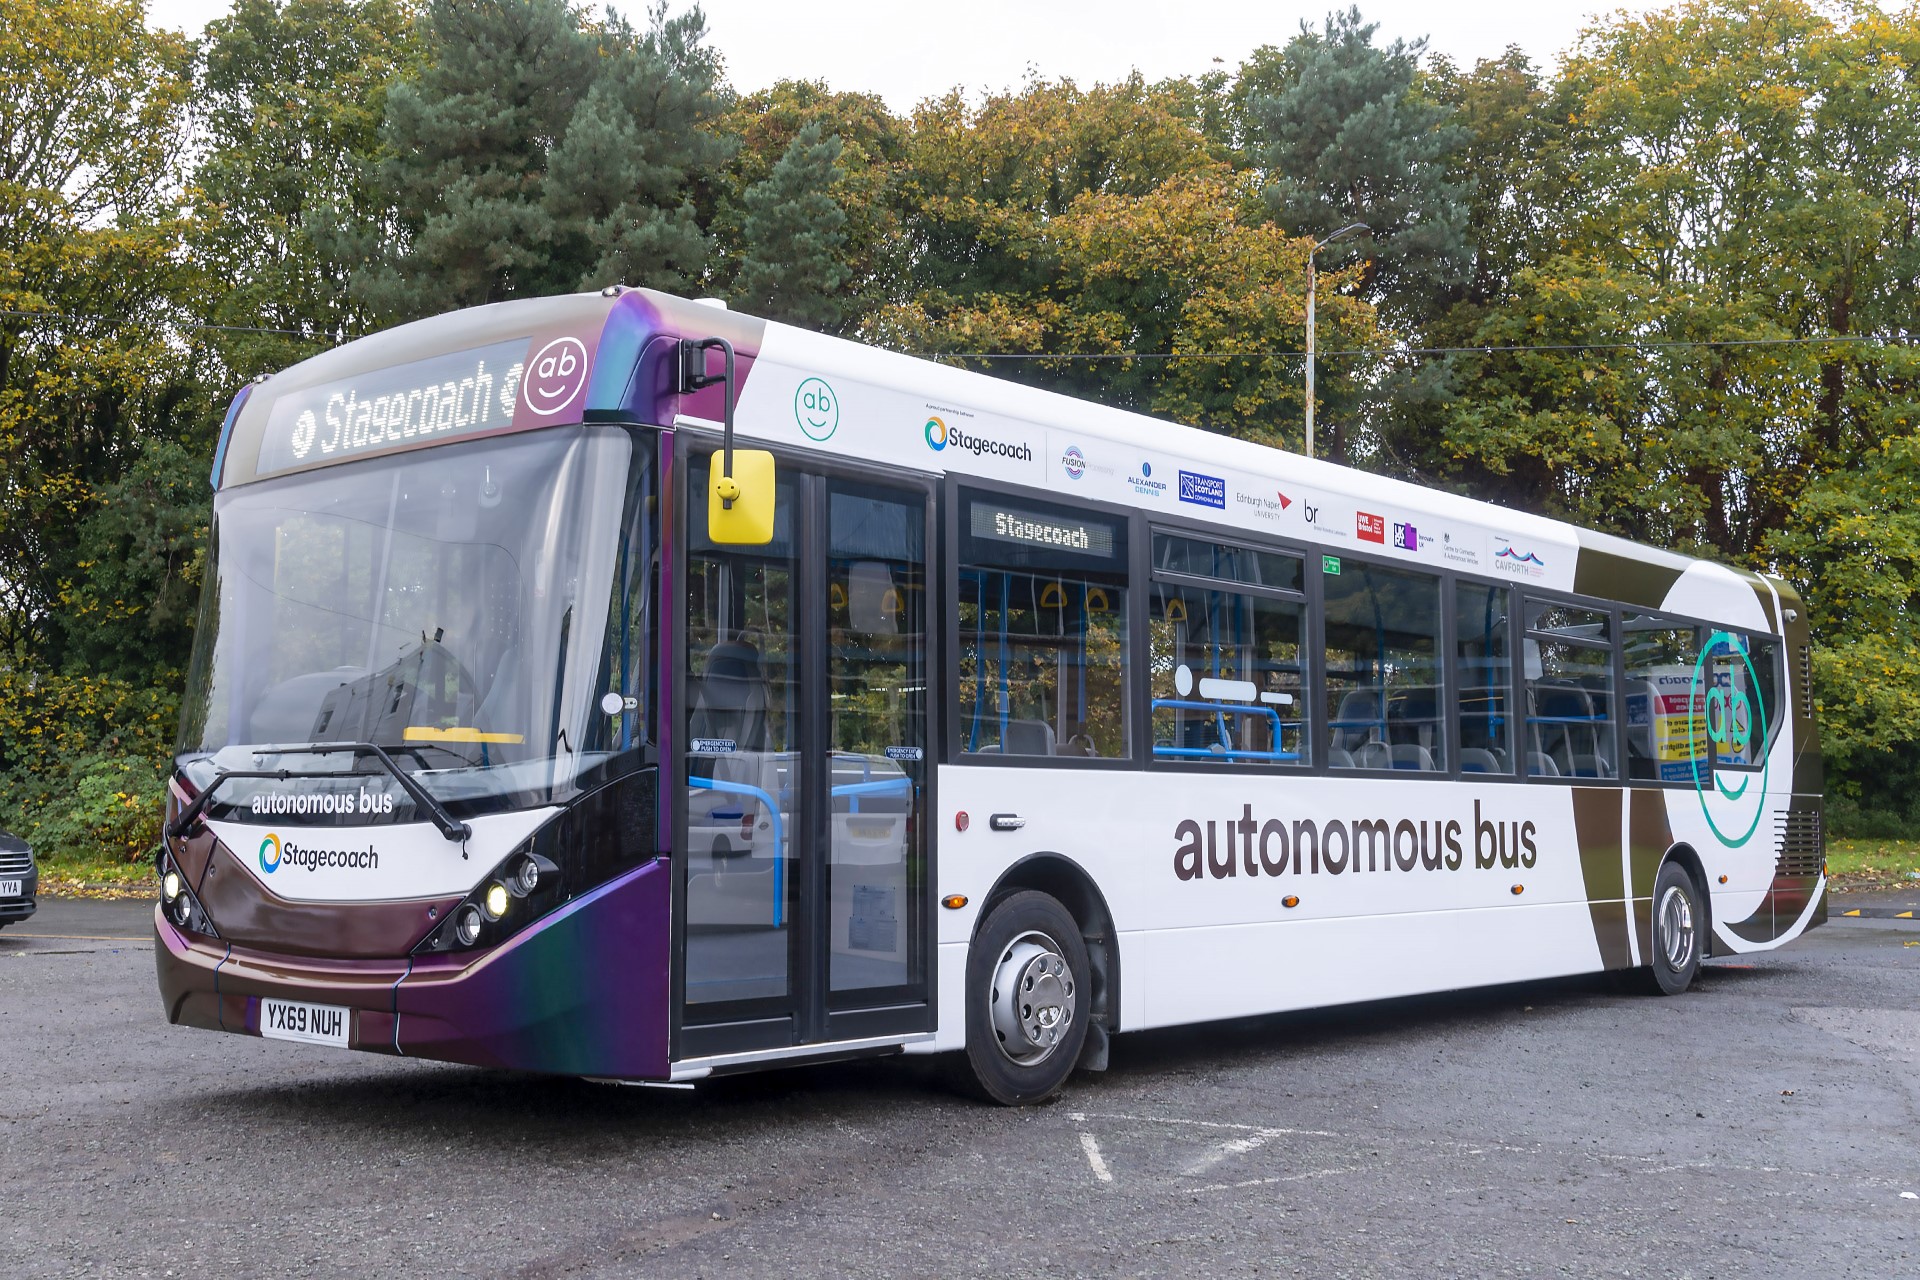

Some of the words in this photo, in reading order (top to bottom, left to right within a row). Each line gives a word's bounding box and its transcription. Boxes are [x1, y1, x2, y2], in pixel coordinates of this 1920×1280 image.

[538, 347, 577, 380] ab
[321, 360, 493, 454] Stagecoach
[803, 387, 830, 412] ab
[949, 427, 1032, 462] Stagecoach
[1062, 456, 1086, 469] FUSION
[1128, 476, 1167, 491] ALEXANDER
[1135, 485, 1160, 497] DENNIS
[1194, 476, 1223, 490] TRANSPORT
[1194, 485, 1223, 498] SCOTLAND
[1236, 492, 1263, 508] Edinburgh
[1263, 498, 1280, 510] Napier
[1253, 509, 1280, 521] UNIVERSITY
[1358, 513, 1369, 525] UWE
[995, 511, 1089, 549] Stagecoach
[1495, 559, 1529, 576] CAVFORTH
[251, 789, 355, 815] autonomous
[359, 786, 393, 814] bus
[1174, 803, 1463, 882] autonomous
[1473, 798, 1537, 870] bus
[282, 841, 379, 872] Stagecoach
[2, 881, 18, 894] YVA
[267, 1003, 307, 1033] YX69
[311, 1008, 342, 1037] NUH
